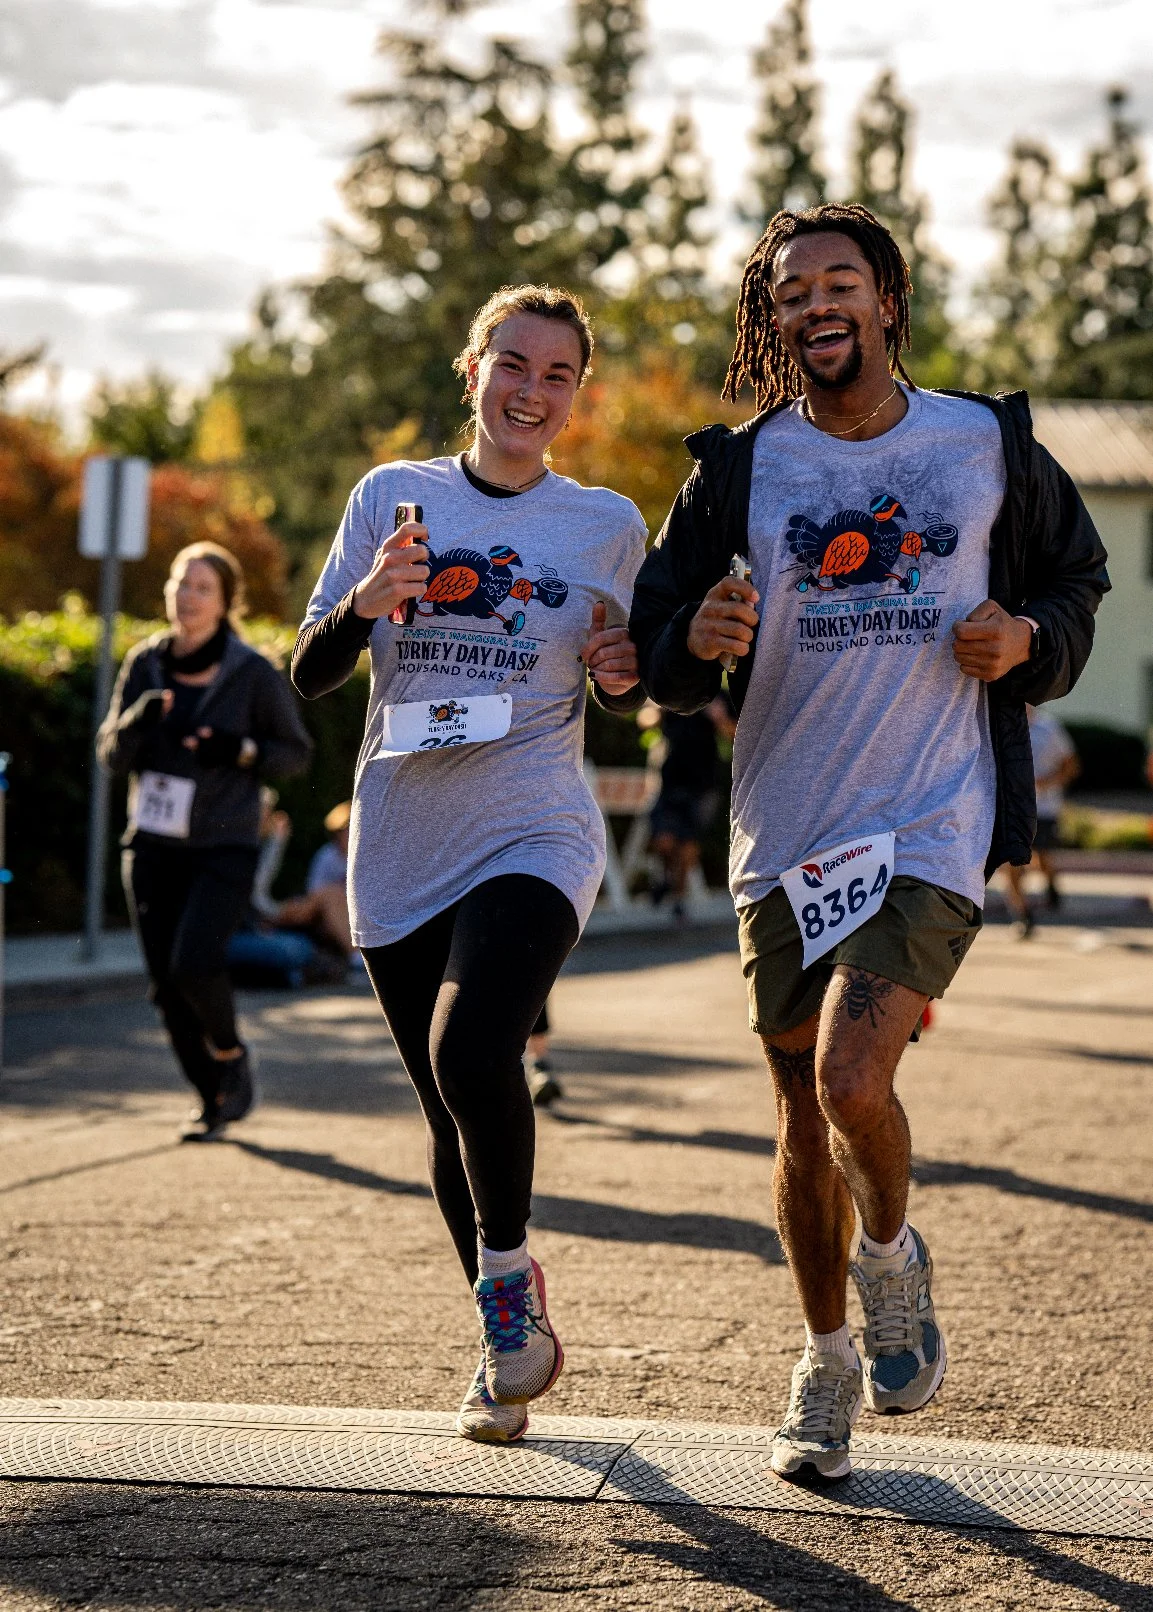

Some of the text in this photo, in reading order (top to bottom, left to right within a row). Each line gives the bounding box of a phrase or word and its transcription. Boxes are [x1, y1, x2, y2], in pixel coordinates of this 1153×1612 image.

[911, 596, 936, 606] 2023
[797, 608, 942, 638] TURKEY DAY DASH
[874, 633, 917, 646] OAKS,
[923, 631, 936, 644] CA
[395, 641, 540, 671] TURKEY DAY DASH
[397, 663, 461, 676] HOUSAND
[466, 668, 508, 683] OAKS,
[822, 843, 873, 874] RaceWire
[802, 862, 889, 940] 8364
